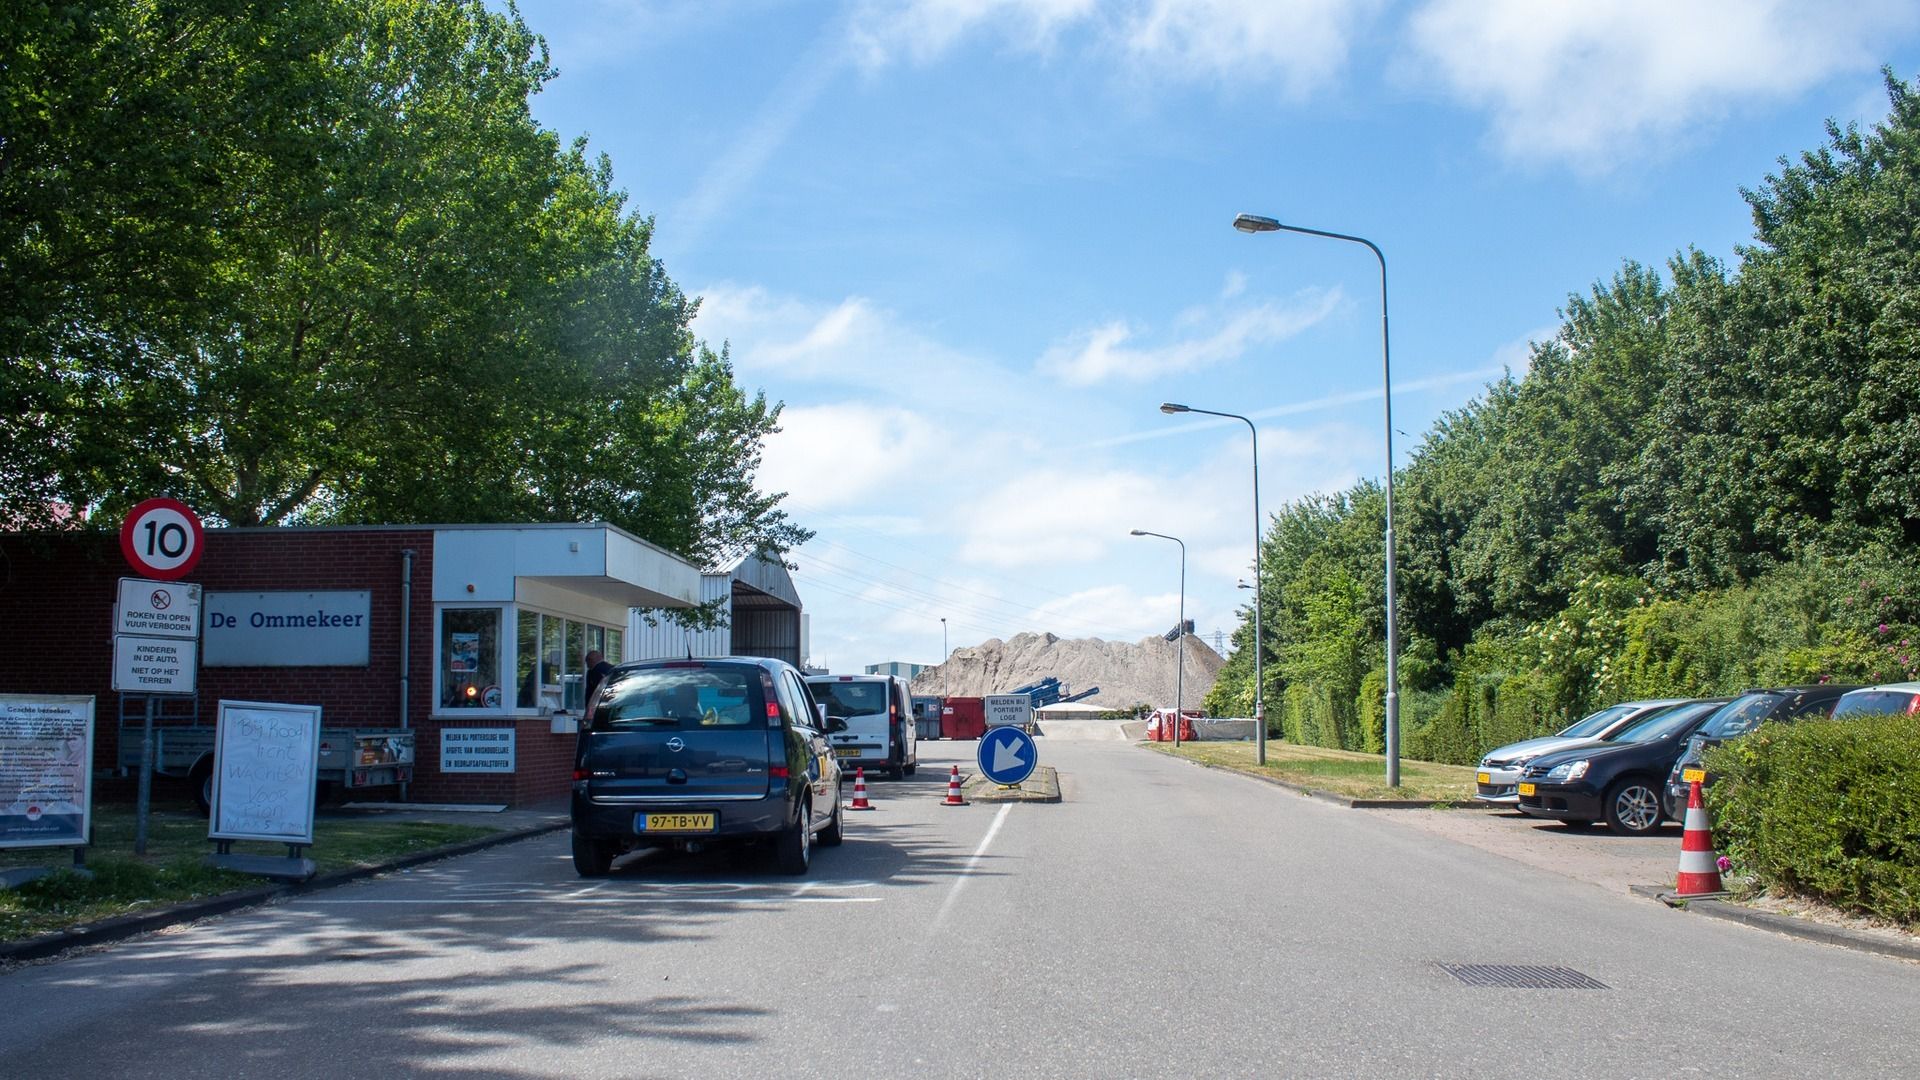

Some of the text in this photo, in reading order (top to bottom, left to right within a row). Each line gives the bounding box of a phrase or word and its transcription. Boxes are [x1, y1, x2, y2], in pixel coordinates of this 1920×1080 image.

[145, 520, 187, 558] 10
[127, 611, 154, 620] ROKEN
[169, 614, 190, 622] OPEN
[210, 610, 364, 628] De Ommekeer
[125, 620, 191, 631] VUUR VERBODEN
[137, 646, 176, 654] KINDEREN
[267, 718, 303, 738] Rood
[264, 820, 272, 830] 5
[651, 816, 708, 828] 97-TB-VV
